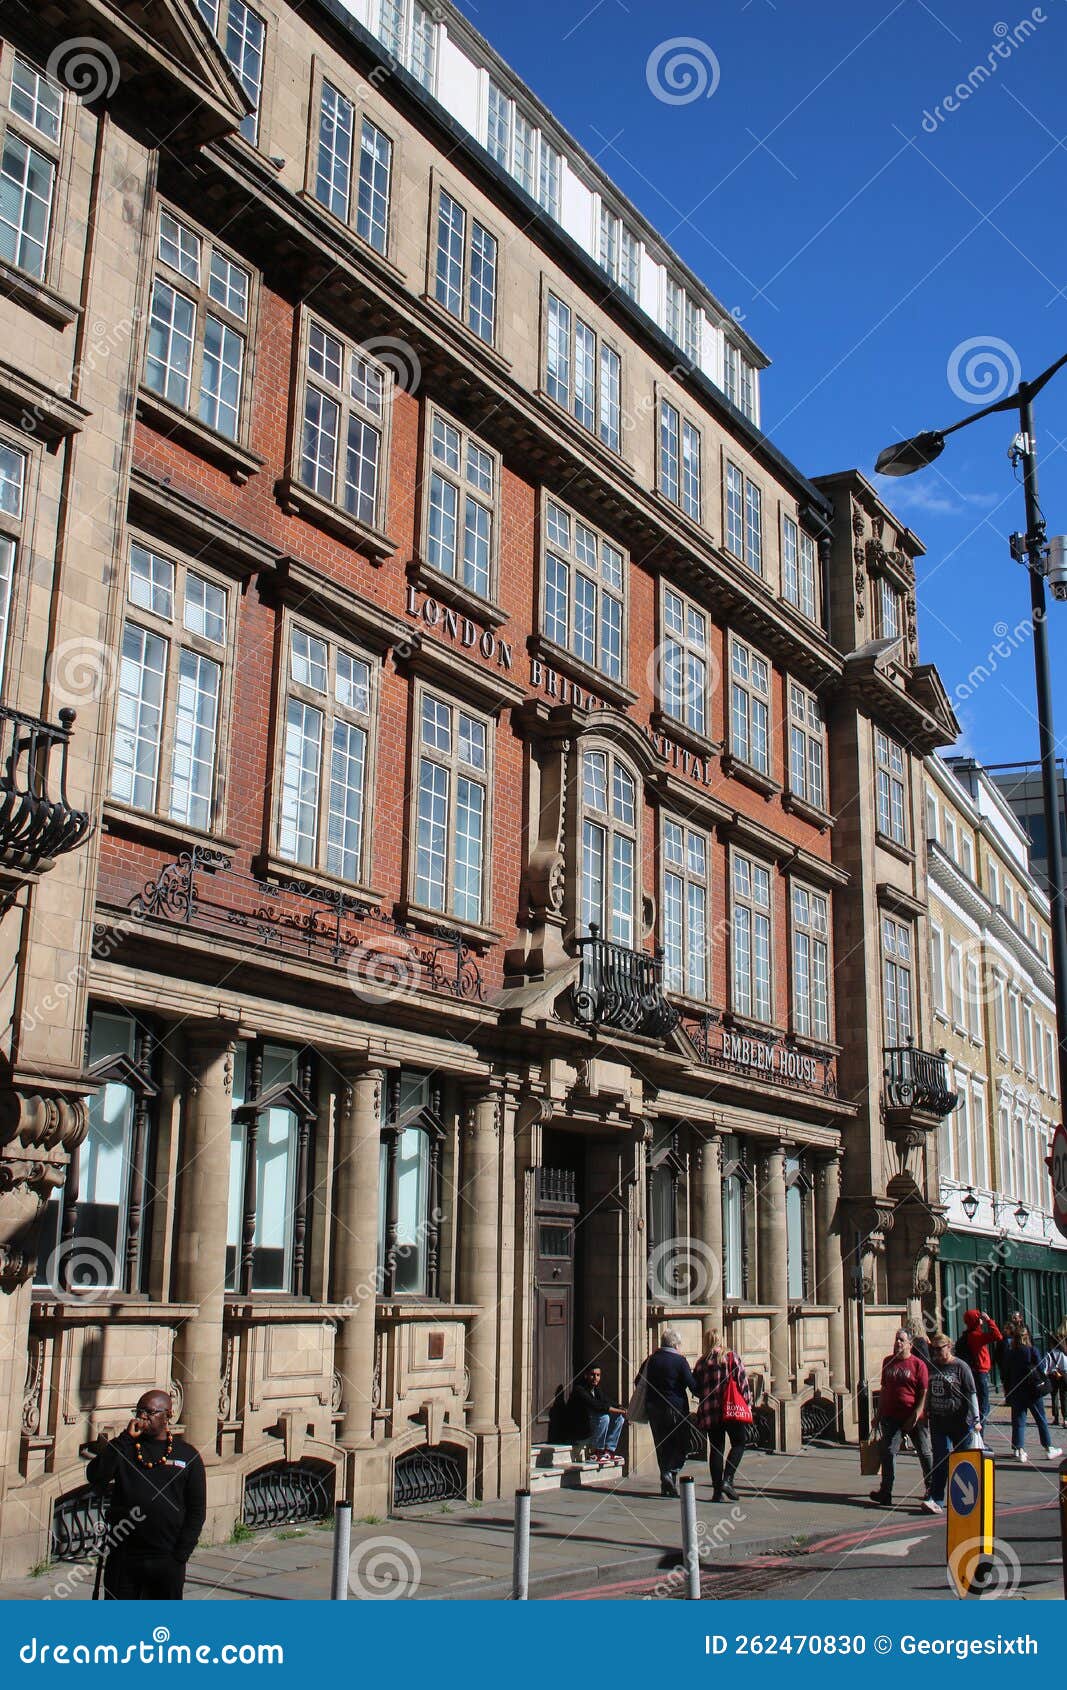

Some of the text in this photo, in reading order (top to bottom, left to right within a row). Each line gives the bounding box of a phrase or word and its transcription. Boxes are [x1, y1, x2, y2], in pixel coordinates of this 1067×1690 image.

[405, 585, 513, 670] LONDON
[641, 725, 713, 787] SPITAL
[722, 1033, 817, 1083] EMBLEM HOUSE
